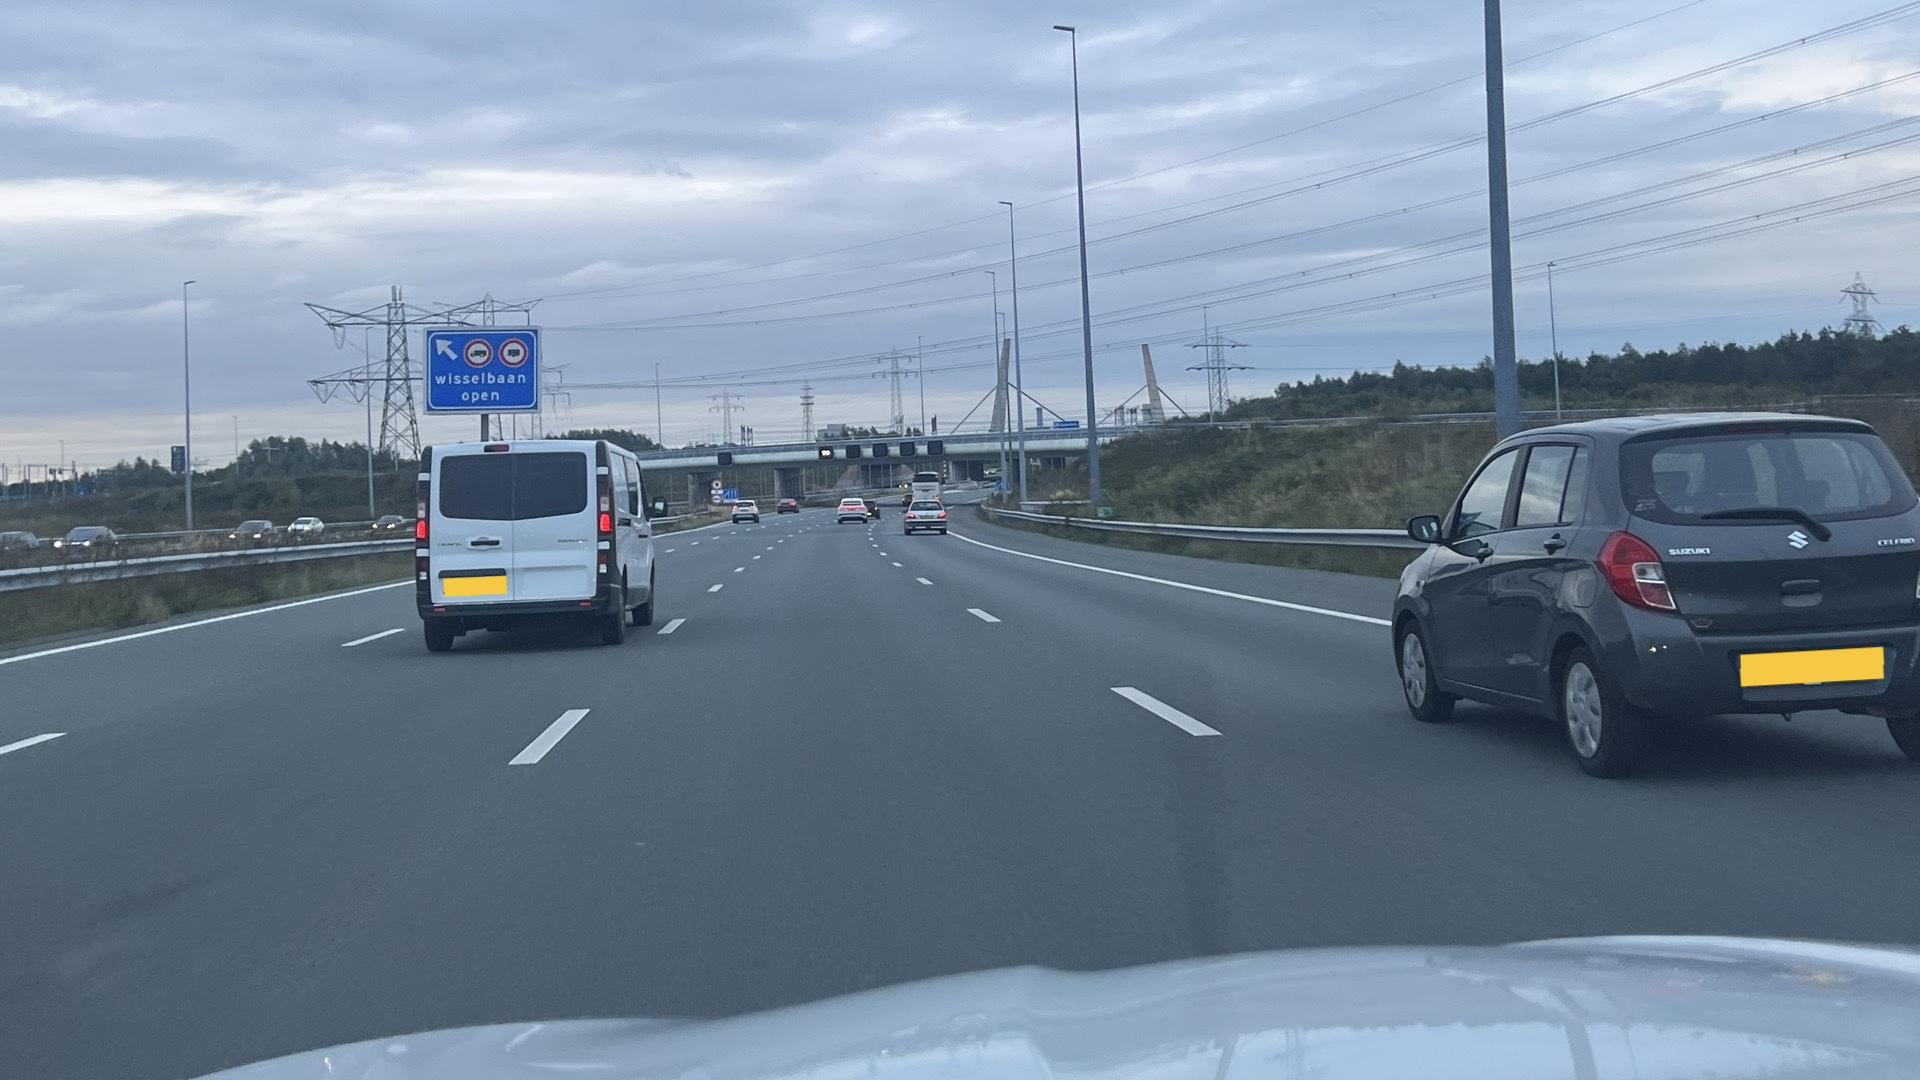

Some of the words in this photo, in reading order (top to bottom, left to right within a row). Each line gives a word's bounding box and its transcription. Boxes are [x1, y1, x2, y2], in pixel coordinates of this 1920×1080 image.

[435, 372, 526, 385] wisselbaan
[461, 391, 500, 403] open
[1668, 547, 1711, 556] SUZUKI
